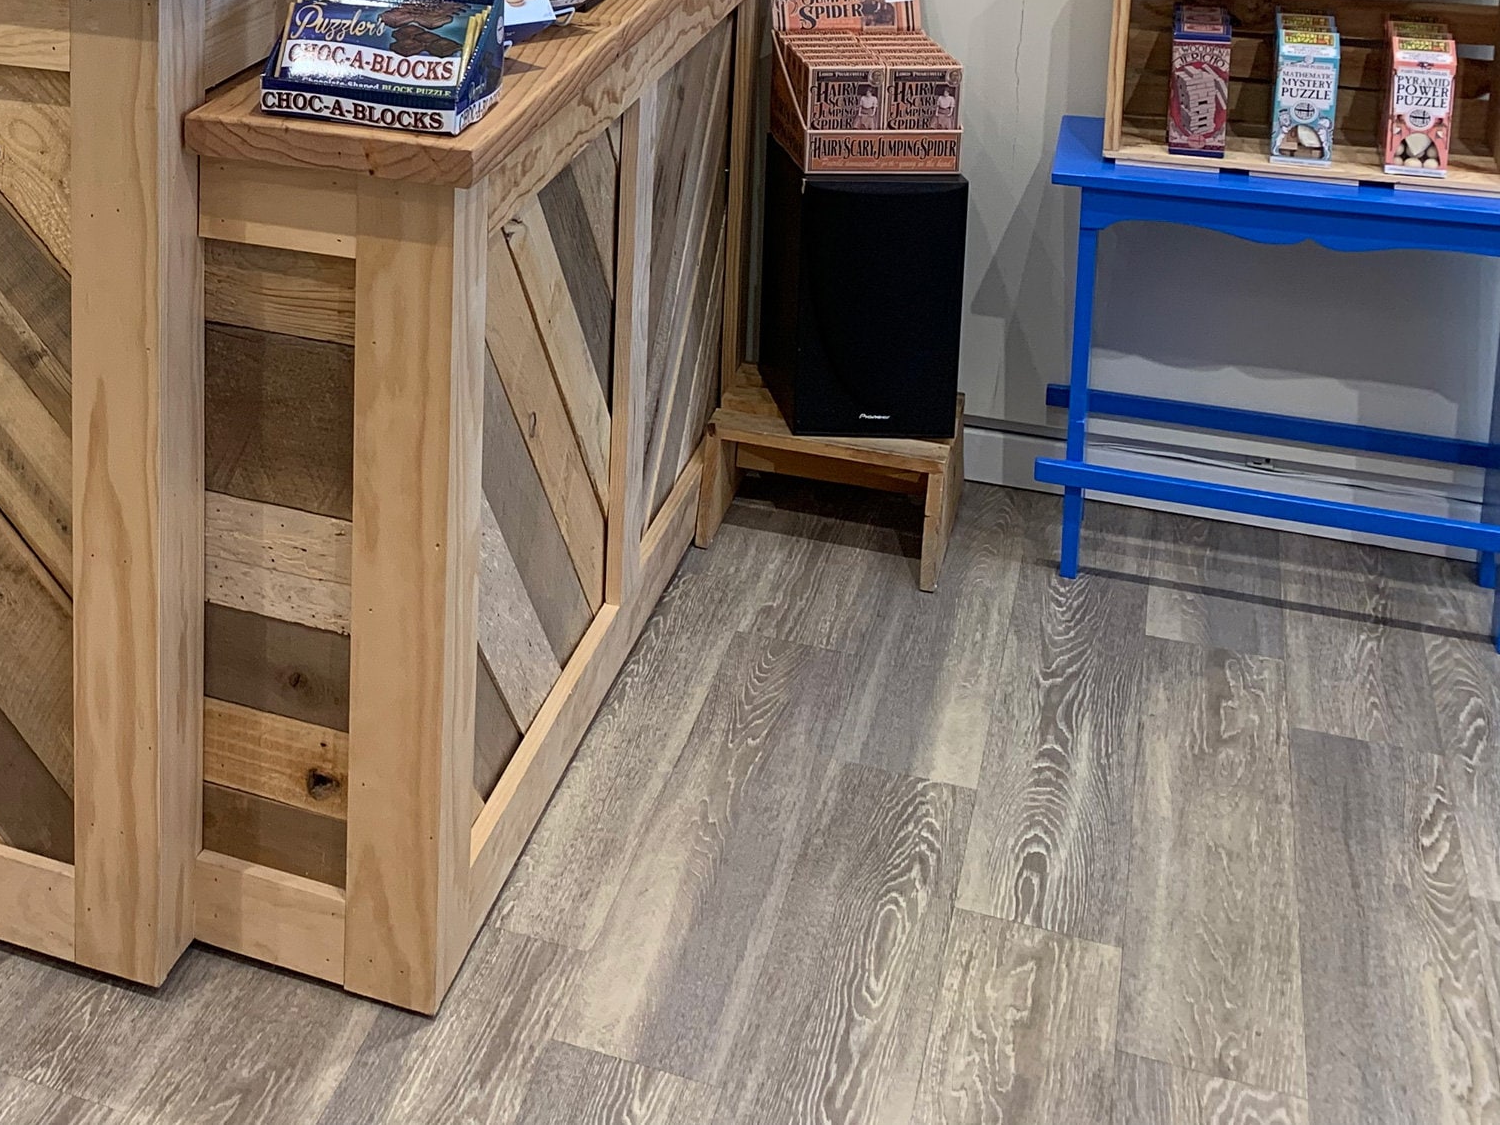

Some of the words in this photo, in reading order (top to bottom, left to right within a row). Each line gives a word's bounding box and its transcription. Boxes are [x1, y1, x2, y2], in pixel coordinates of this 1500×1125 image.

[291, 2, 386, 41] Puzzler's
[799, 3, 863, 30] SPIDER
[1181, 45, 1226, 57] WOODEN
[288, 43, 454, 81] CHOC-A-BLOCKS
[1178, 53, 1226, 68] JERICHO
[1282, 70, 1333, 79] MATHEMATIC
[1397, 75, 1450, 88] PYRAMID
[1281, 78, 1333, 89] MYSTERY
[811, 82, 858, 103] HAIRY
[888, 82, 935, 103] HAIRY
[1281, 87, 1332, 101] PUZZLE
[1396, 84, 1449, 98] POWER
[828, 96, 860, 108] SCARY
[905, 96, 937, 108] SCARY
[1395, 95, 1448, 109] PUZZLE
[262, 91, 443, 130] CHOC-A-BLOCKS
[810, 118, 854, 130] SPIDER
[887, 118, 930, 130] SPIDER
